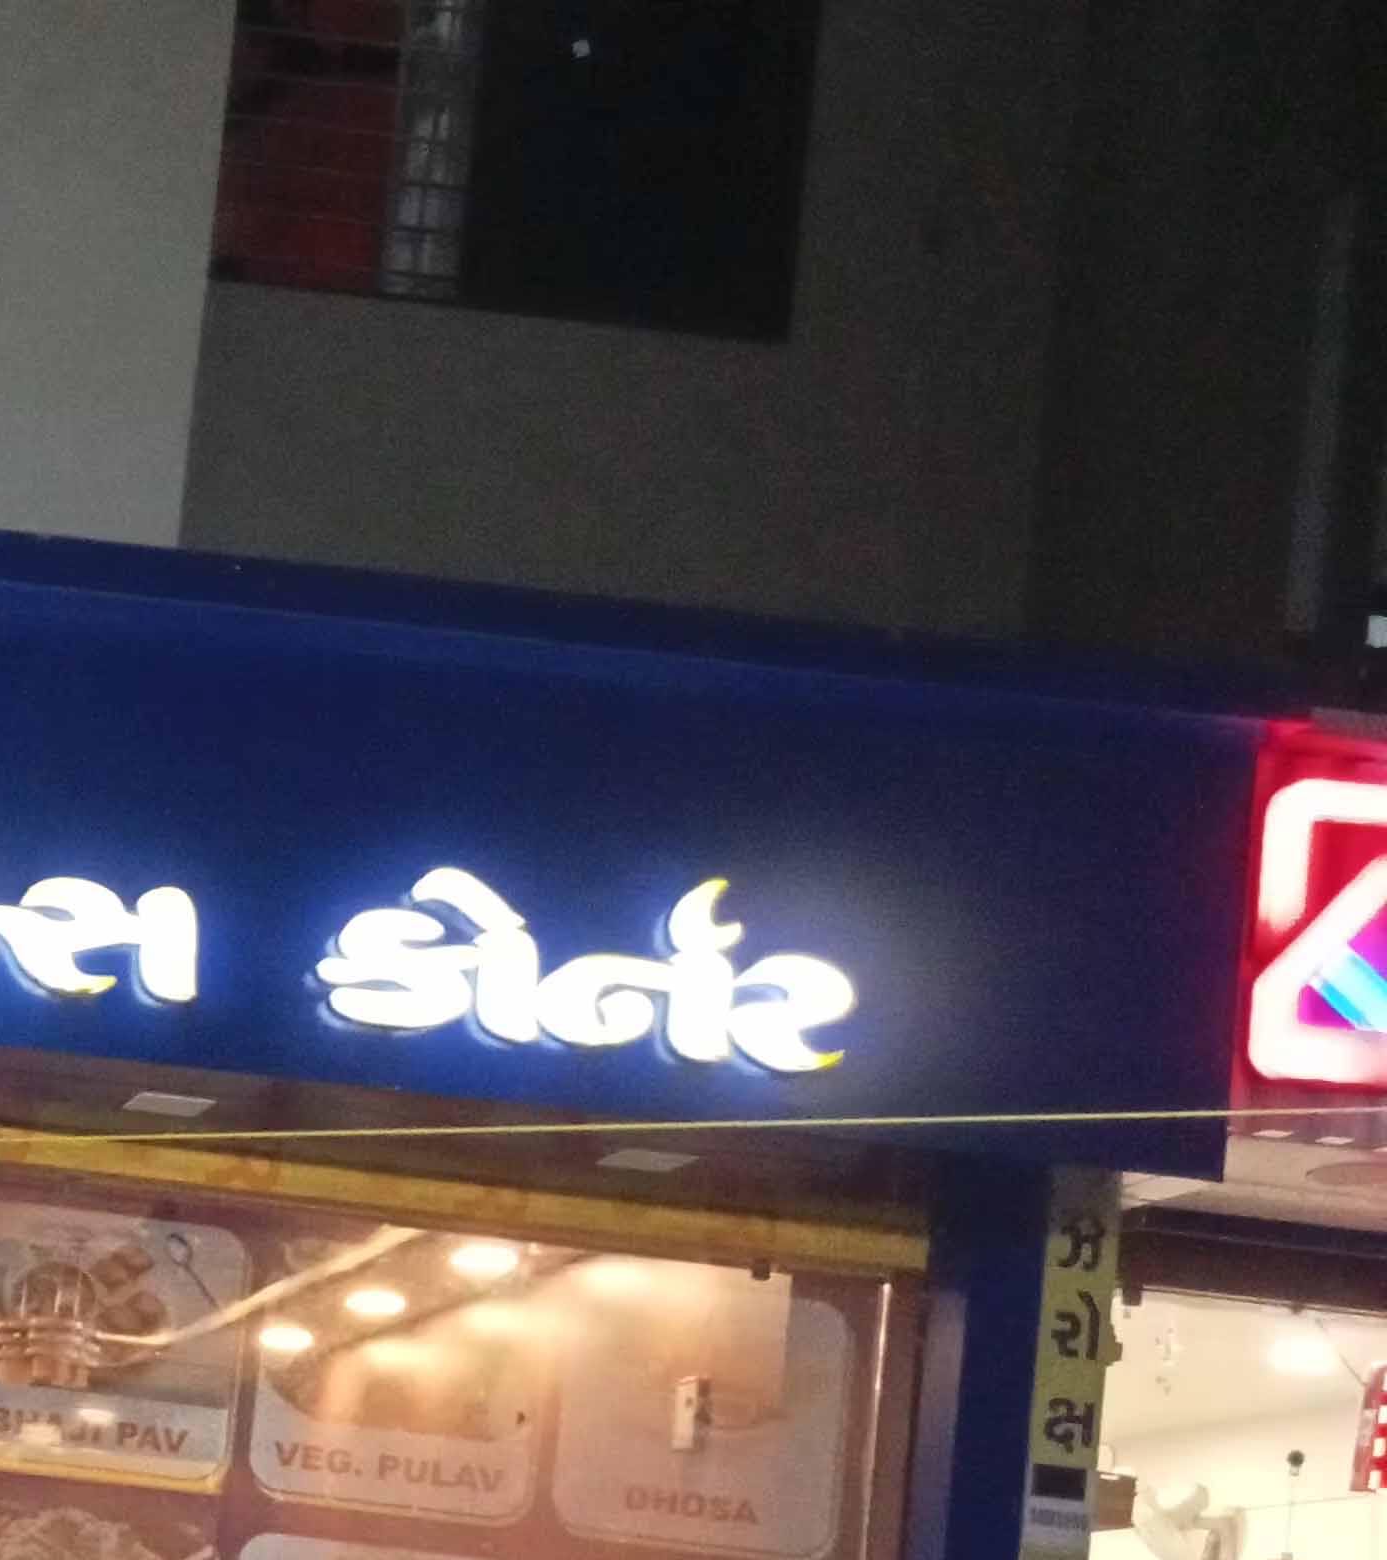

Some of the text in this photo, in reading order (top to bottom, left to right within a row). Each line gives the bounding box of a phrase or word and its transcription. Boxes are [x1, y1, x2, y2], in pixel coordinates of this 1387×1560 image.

[316, 867, 856, 1072] કોર્નર
[117, 1422, 189, 1454] PAV
[275, 1440, 505, 1496] VEG. PULAV
[627, 1484, 758, 1527] DHOSA
